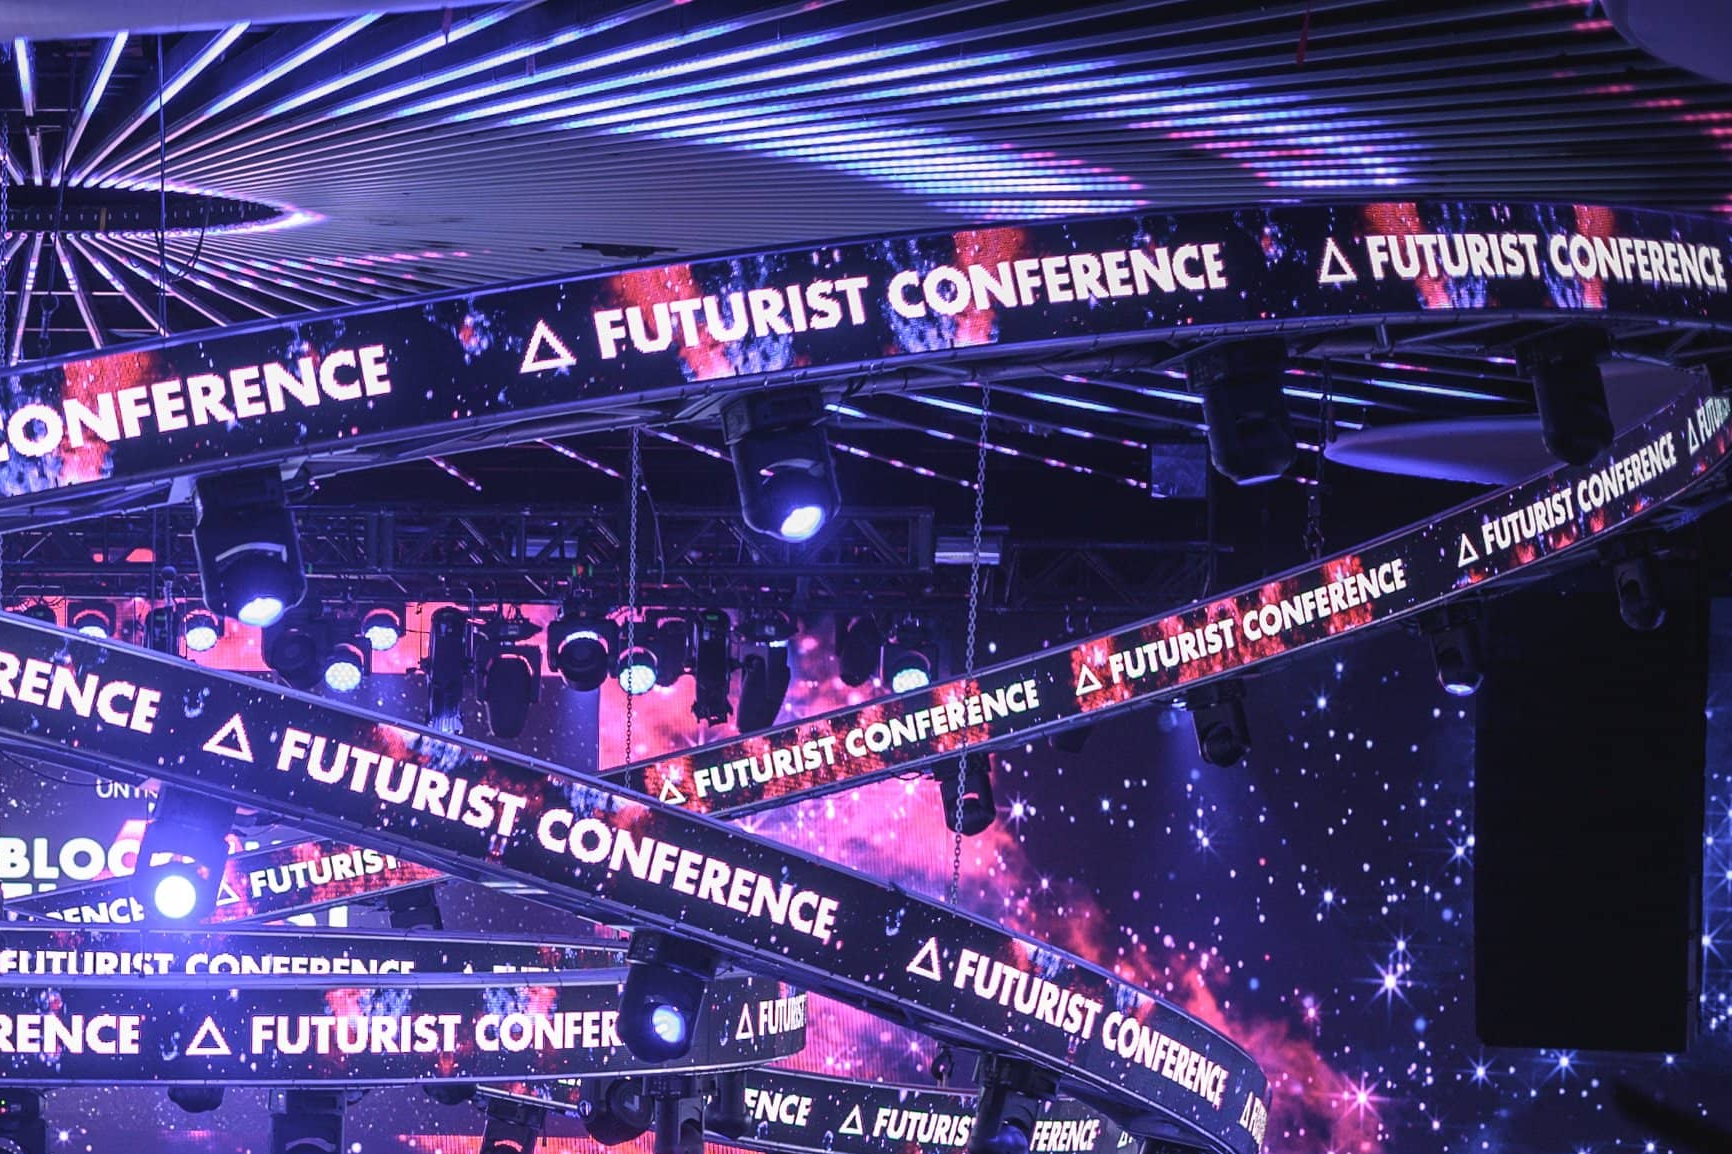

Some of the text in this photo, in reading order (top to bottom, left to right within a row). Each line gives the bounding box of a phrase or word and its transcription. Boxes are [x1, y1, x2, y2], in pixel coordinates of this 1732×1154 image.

[593, 241, 1228, 360] FUTURIST CONFERENCE
[1366, 233, 1728, 293] FUTURIST CONFERENCE
[1481, 432, 1677, 555] FUTURIST CONFERENCE
[1107, 558, 1408, 685] FUTURIST CONFERENCE
[692, 679, 1040, 799] FUTURIST CONFERENCE
[276, 727, 840, 941] FUTURIST CONFERENCE
[251, 1010, 624, 1055] FUTURIST CONFER
[953, 948, 1230, 1107] FUTURIST CONFERENCE
[873, 1106, 977, 1147] FUTURIS
[1030, 1119, 1100, 1152] FERENCE
